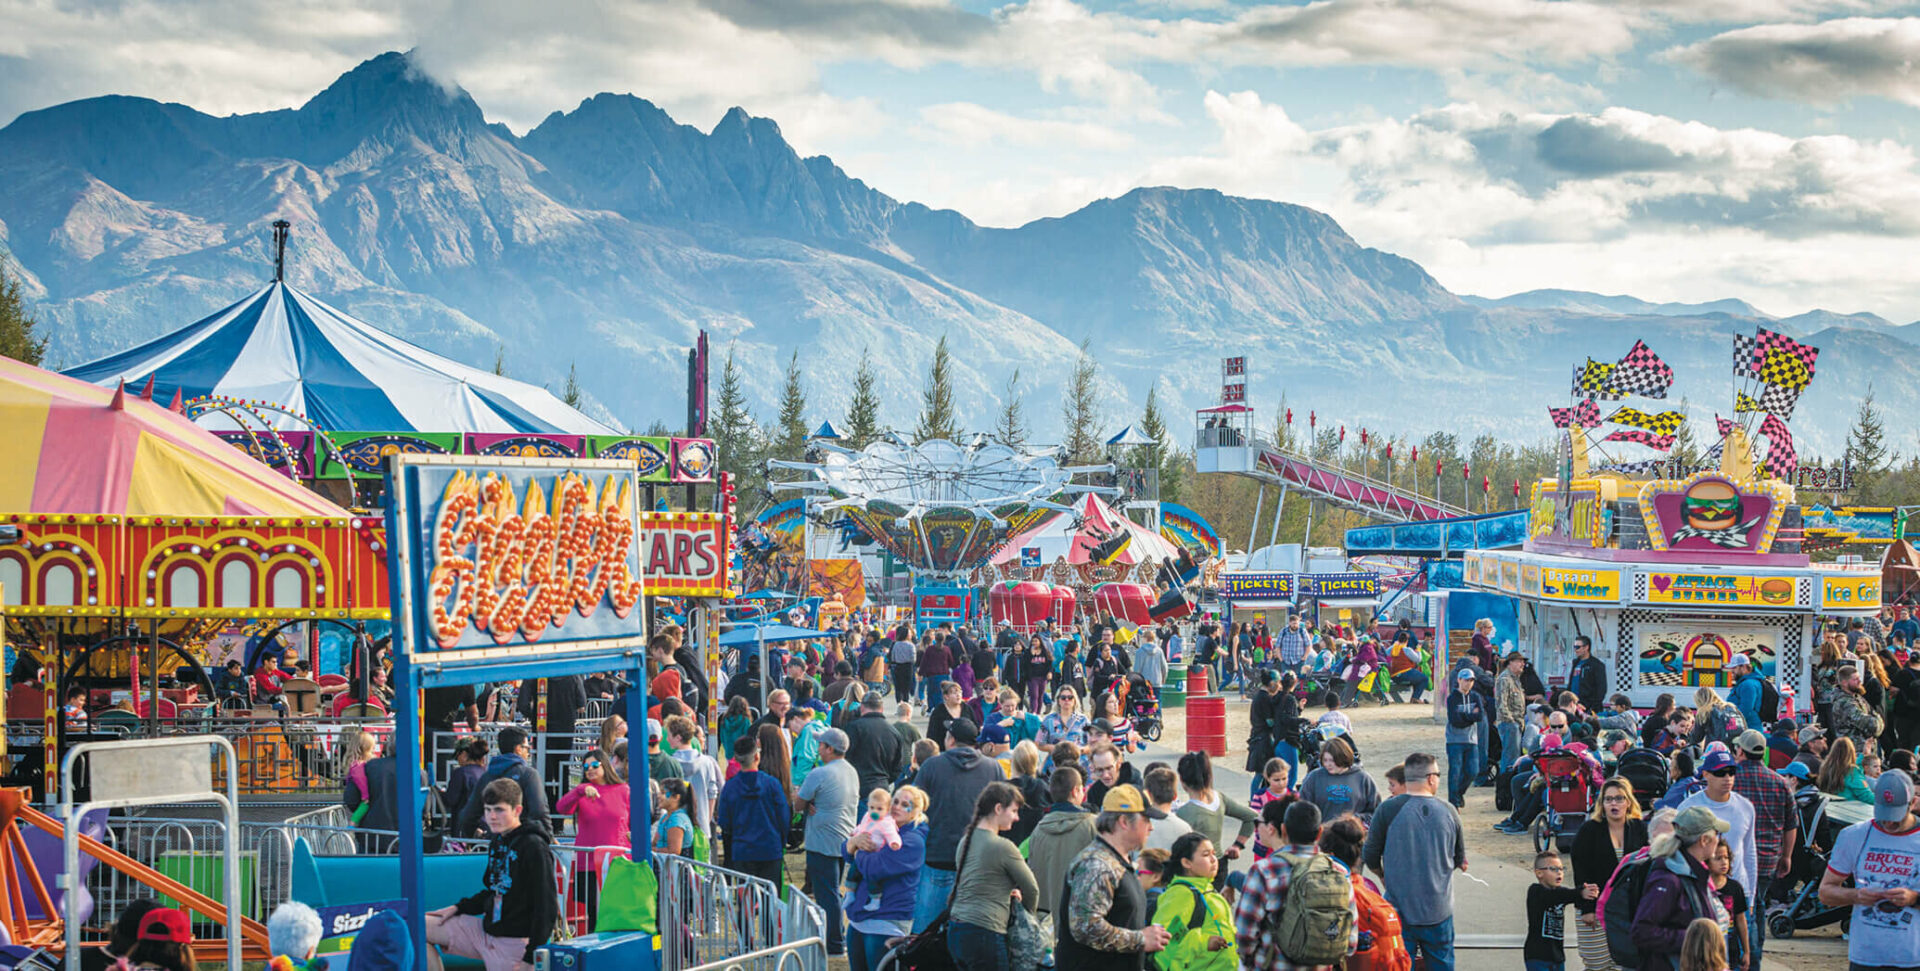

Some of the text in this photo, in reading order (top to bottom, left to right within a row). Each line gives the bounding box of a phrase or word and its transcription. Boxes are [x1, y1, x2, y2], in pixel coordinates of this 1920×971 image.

[641, 533, 715, 576] ARS
[1548, 570, 1597, 583] Dasani
[1673, 575, 1737, 589] ATTACK
[1231, 579, 1289, 592] TICKETS
[1319, 579, 1375, 592] TICKETS
[1563, 582, 1610, 597] Water
[1826, 582, 1852, 601] Ice
[1672, 590, 1738, 601] BURGER
[1864, 852, 1914, 866] BRUCE
[1871, 864, 1912, 877] LOOSE
